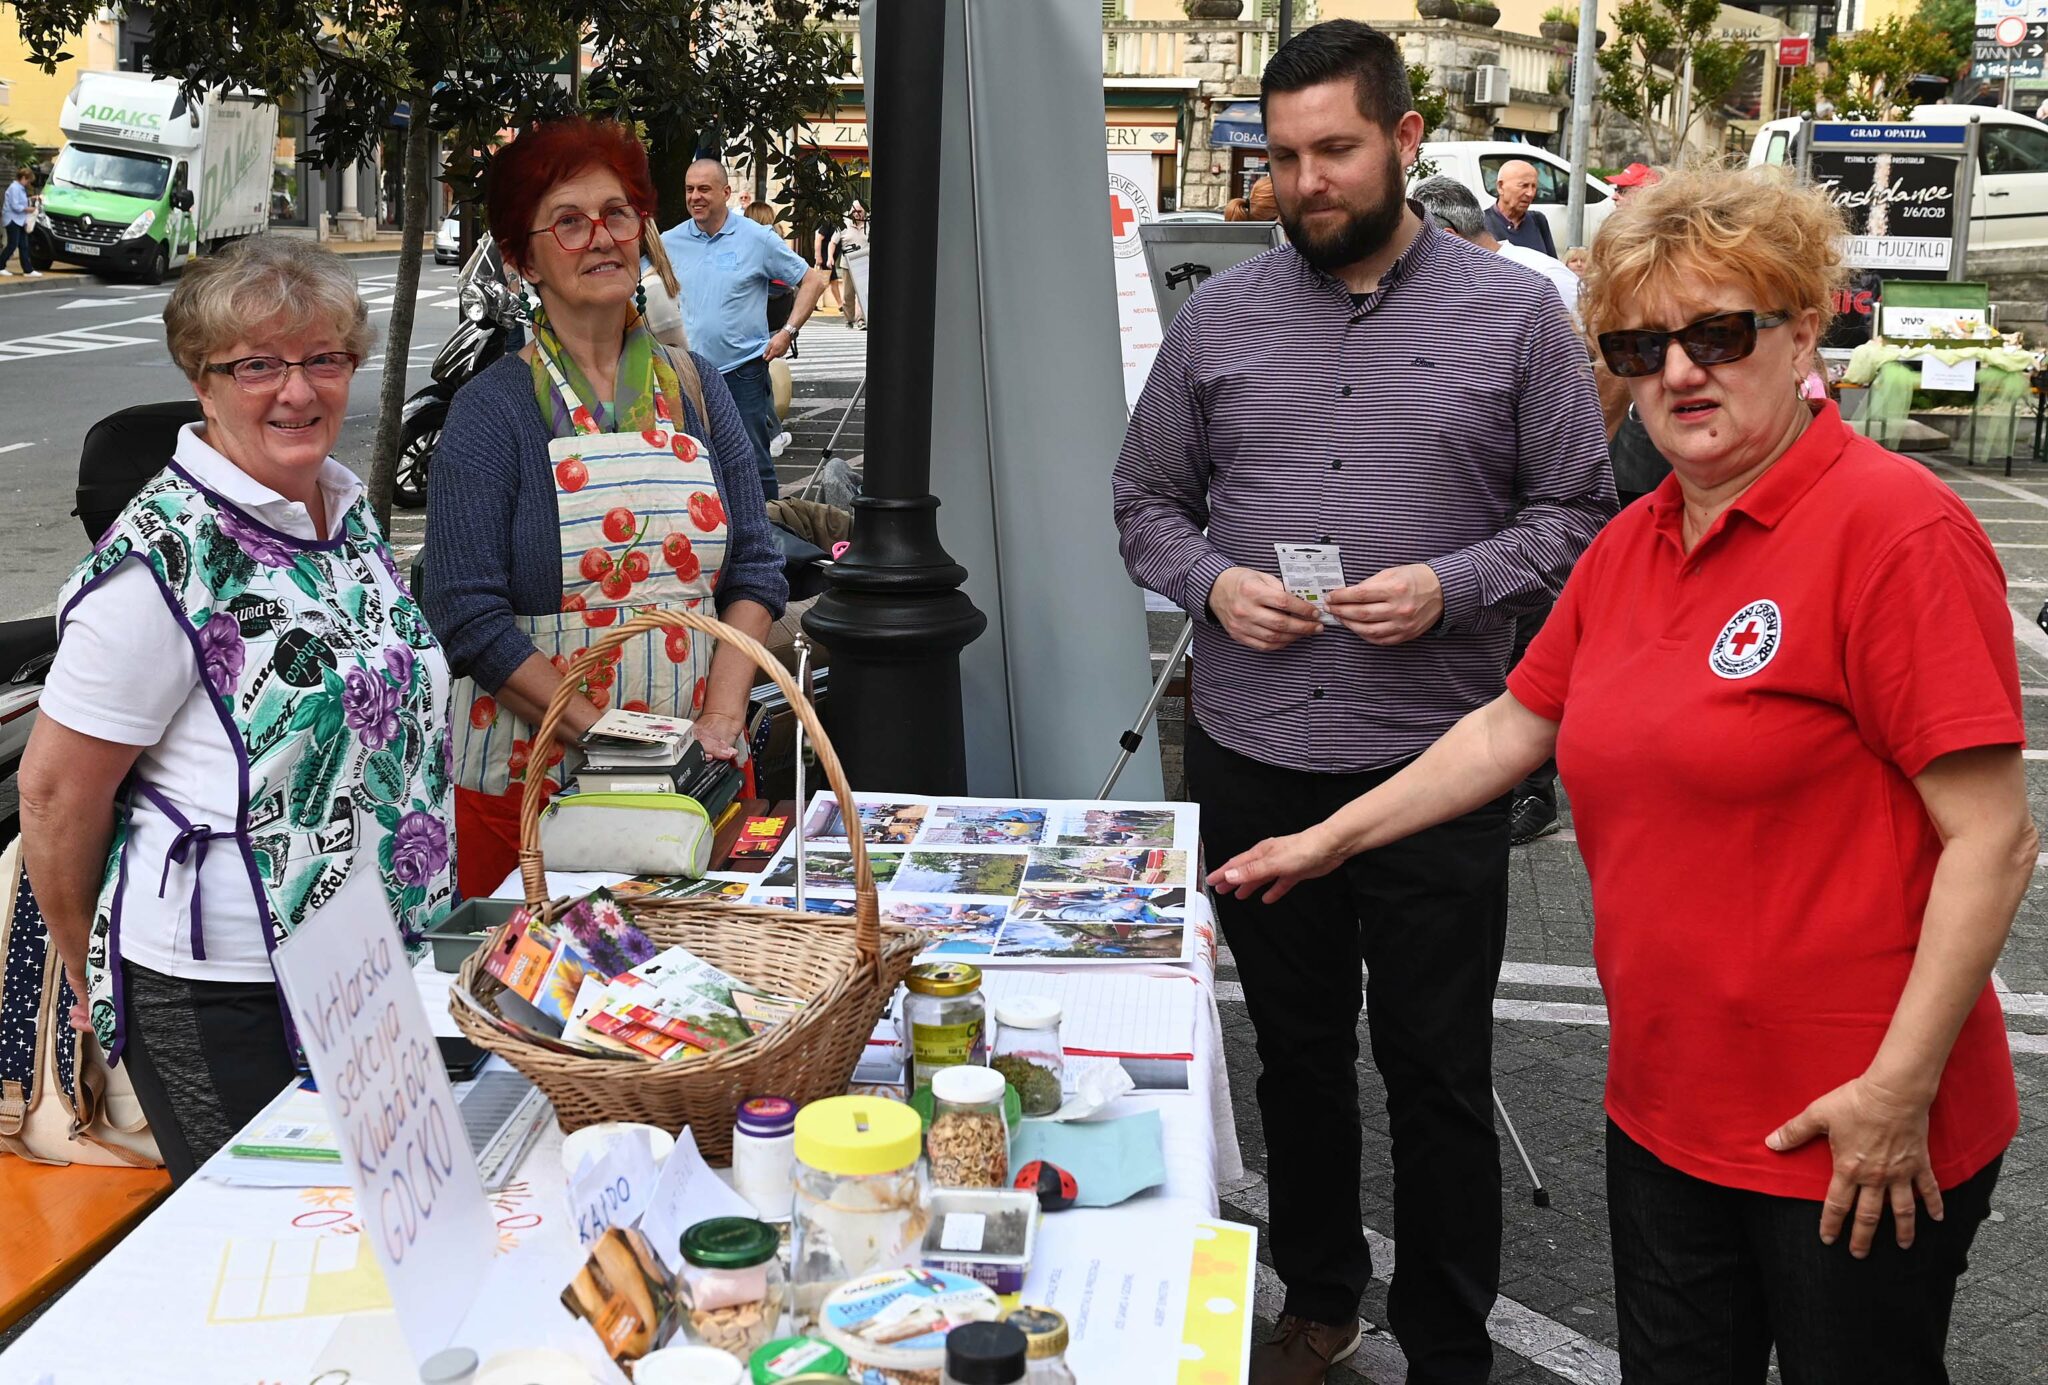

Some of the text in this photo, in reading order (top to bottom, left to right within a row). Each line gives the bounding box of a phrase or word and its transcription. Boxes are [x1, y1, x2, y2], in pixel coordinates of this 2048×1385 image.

[1976, 27, 1997, 39] eug
[81, 104, 161, 128] ADAKS
[834, 126, 868, 143] ZLA
[1850, 128, 1927, 139] GRAD OPATIJA
[1877, 241, 1944, 258] MJUZIKLA
[352, 746, 370, 780] BIEREN
[302, 936, 392, 1054] Vrtlarska
[336, 1000, 401, 1118] sekcija
